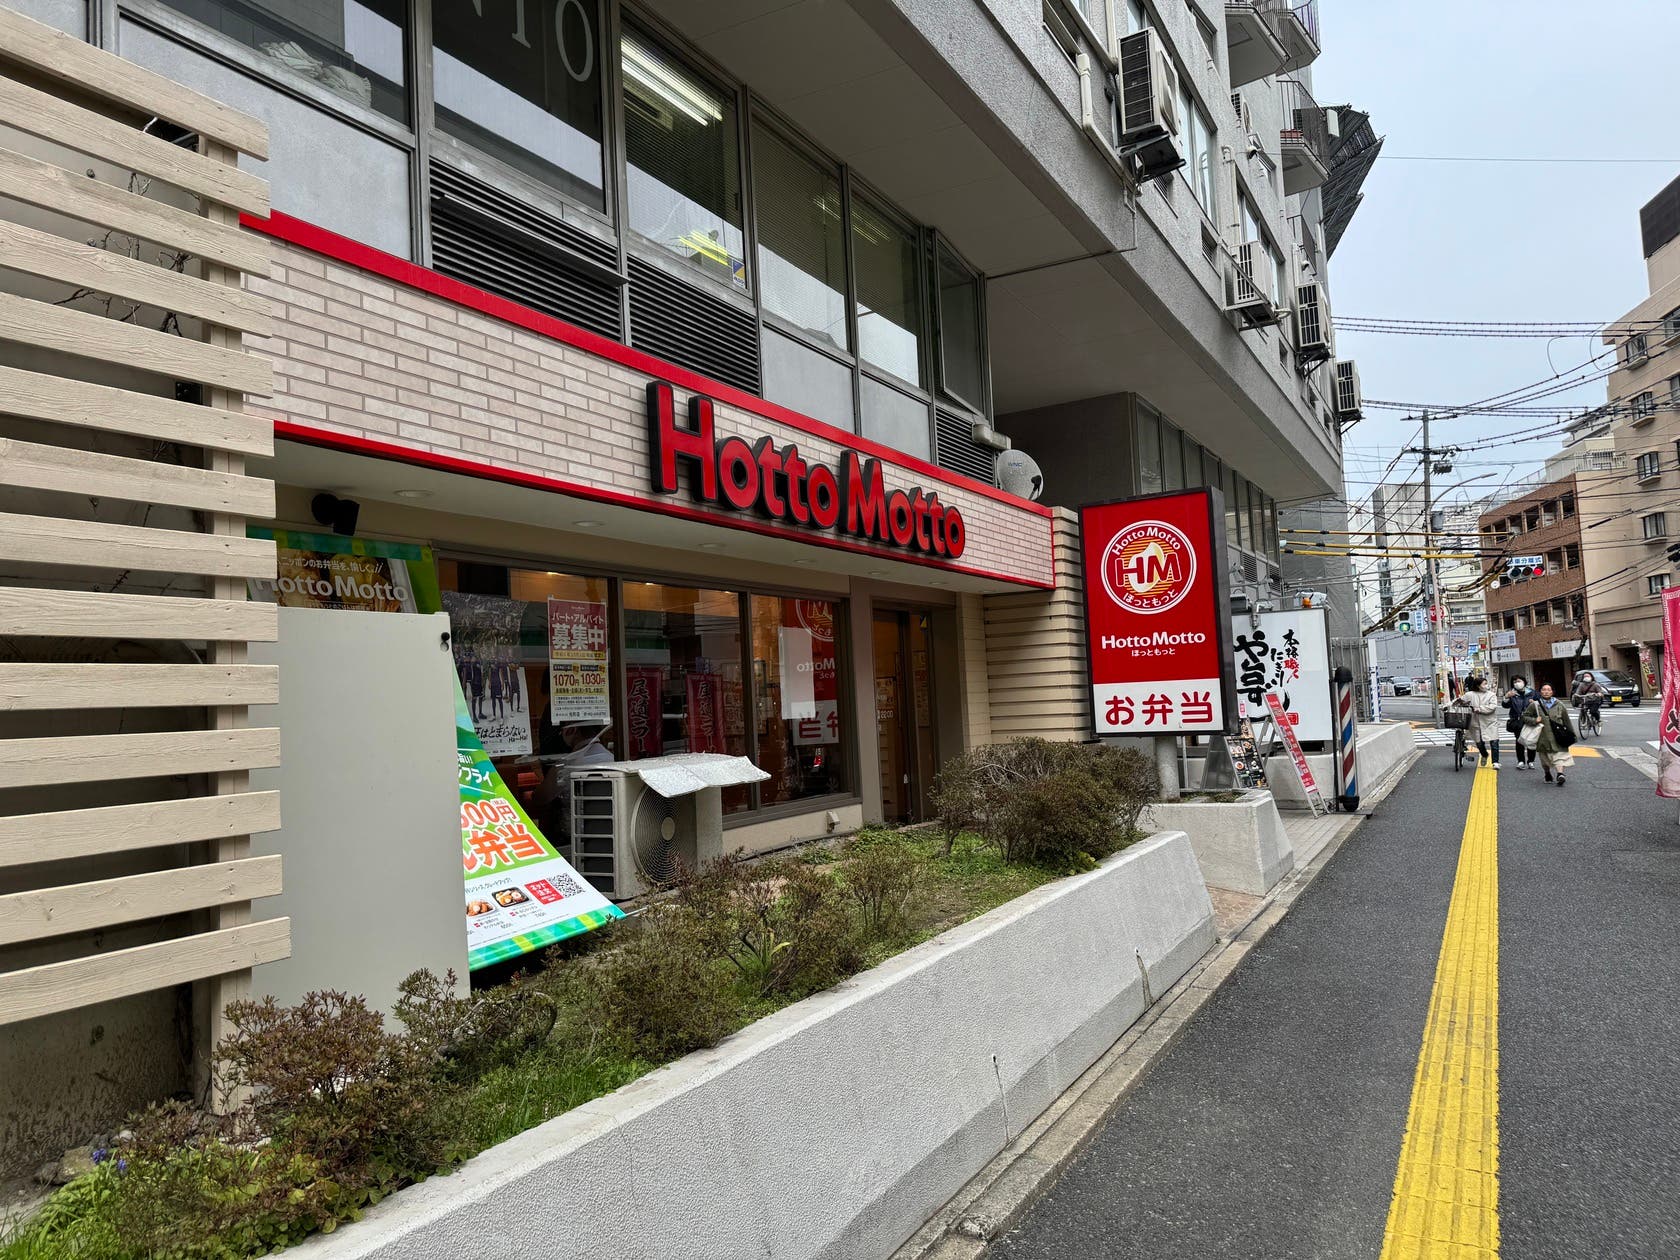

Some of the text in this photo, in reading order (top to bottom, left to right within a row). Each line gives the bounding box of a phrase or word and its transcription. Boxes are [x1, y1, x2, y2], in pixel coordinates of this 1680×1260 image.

[1115, 552, 1182, 587] HM
[1123, 588, 1178, 607] ほっともっと
[552, 623, 604, 650] 募集中
[1131, 647, 1176, 657] ほっともっと
[1105, 691, 1214, 726] お弁当
